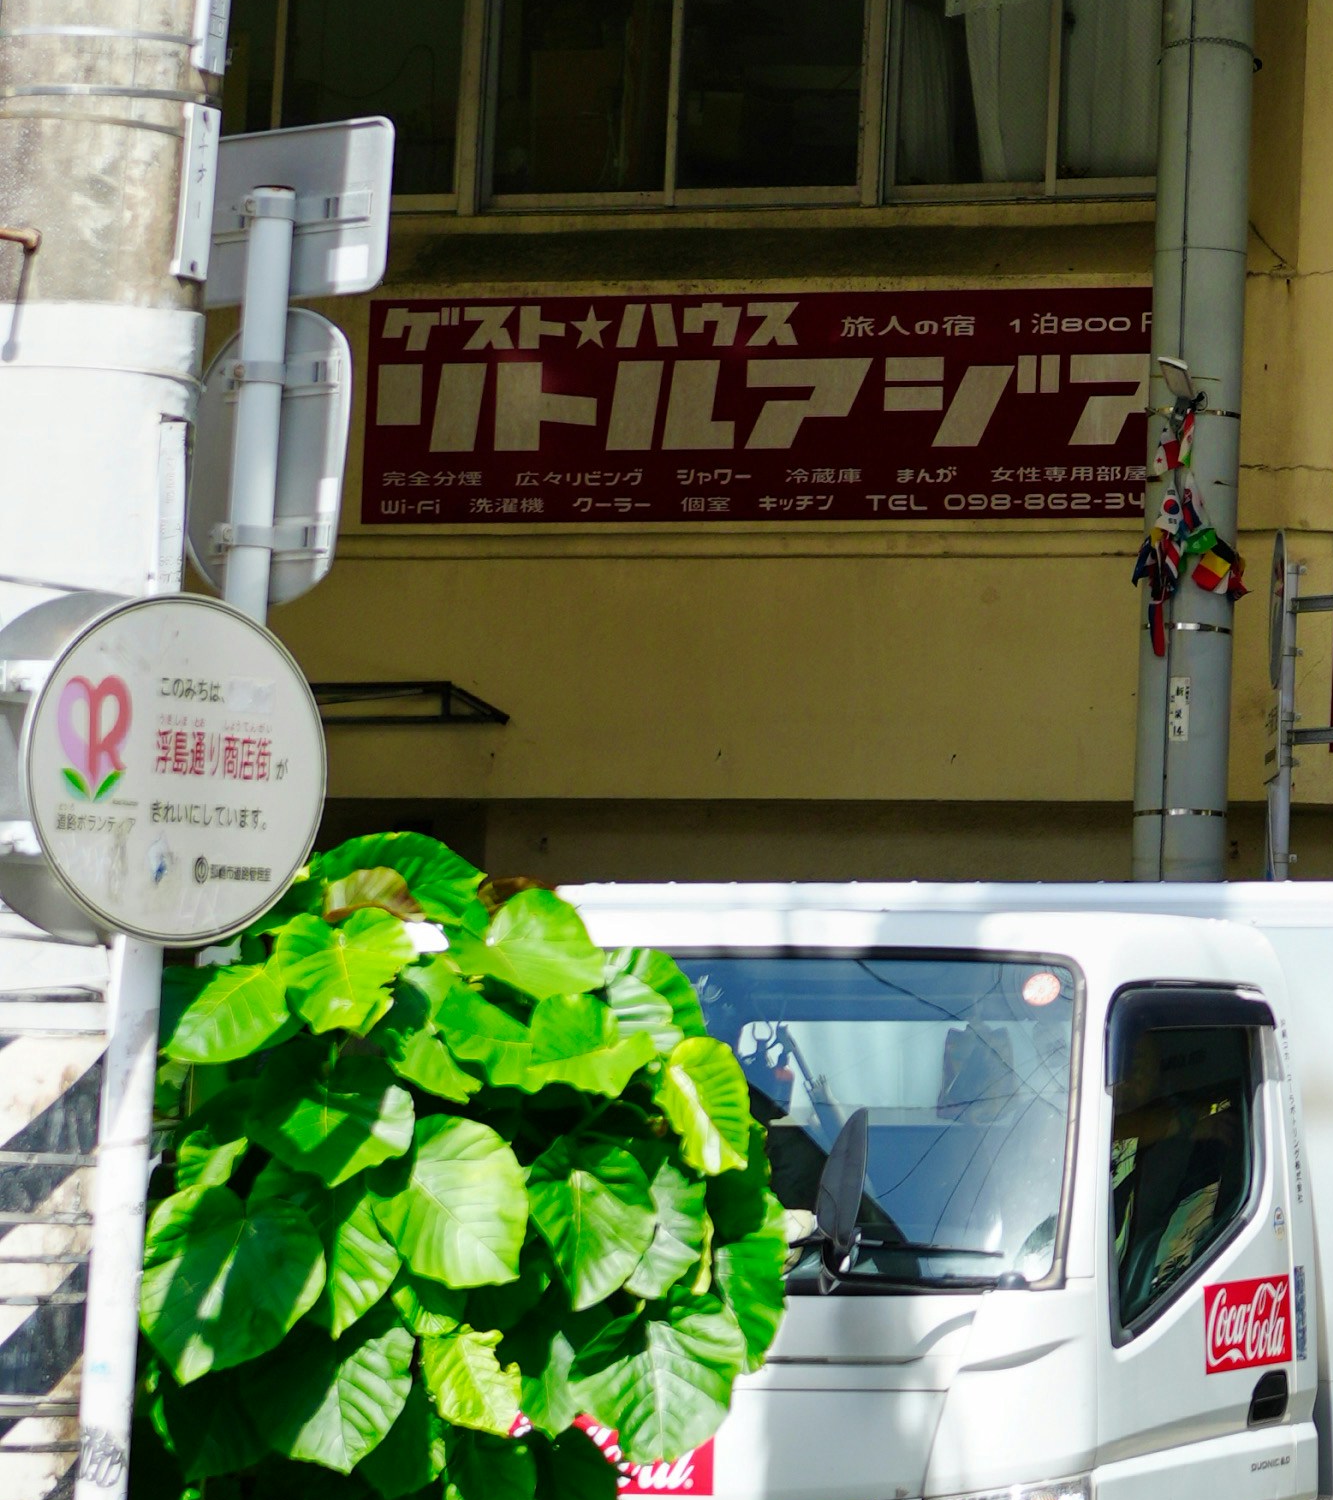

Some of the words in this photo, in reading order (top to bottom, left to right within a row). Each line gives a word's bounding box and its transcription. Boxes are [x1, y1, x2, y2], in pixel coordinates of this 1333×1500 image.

[841, 313, 976, 339] 旅人の宿
[375, 353, 1152, 453] リトルアジア
[381, 468, 483, 487] 完全分煙
[515, 466, 643, 488] 広々リビング
[675, 467, 752, 486] シャワー
[785, 466, 862, 487] 冷蔵庫
[896, 466, 959, 486] まんが
[990, 465, 1148, 486] 女性専用部屋
[379, 497, 442, 516] Wi-Fi
[469, 496, 546, 515] 洗濯機
[572, 494, 652, 514] クーラー
[680, 494, 732, 514] 個室
[757, 493, 835, 512] キッチン
[866, 492, 928, 512] TEL
[943, 491, 1147, 512] 098-862-34
[160, 677, 226, 704] このみちは、
[154, 728, 272, 782] 浮島通り商店街
[275, 759, 289, 780] が
[150, 801, 269, 831] きれいにしています。
